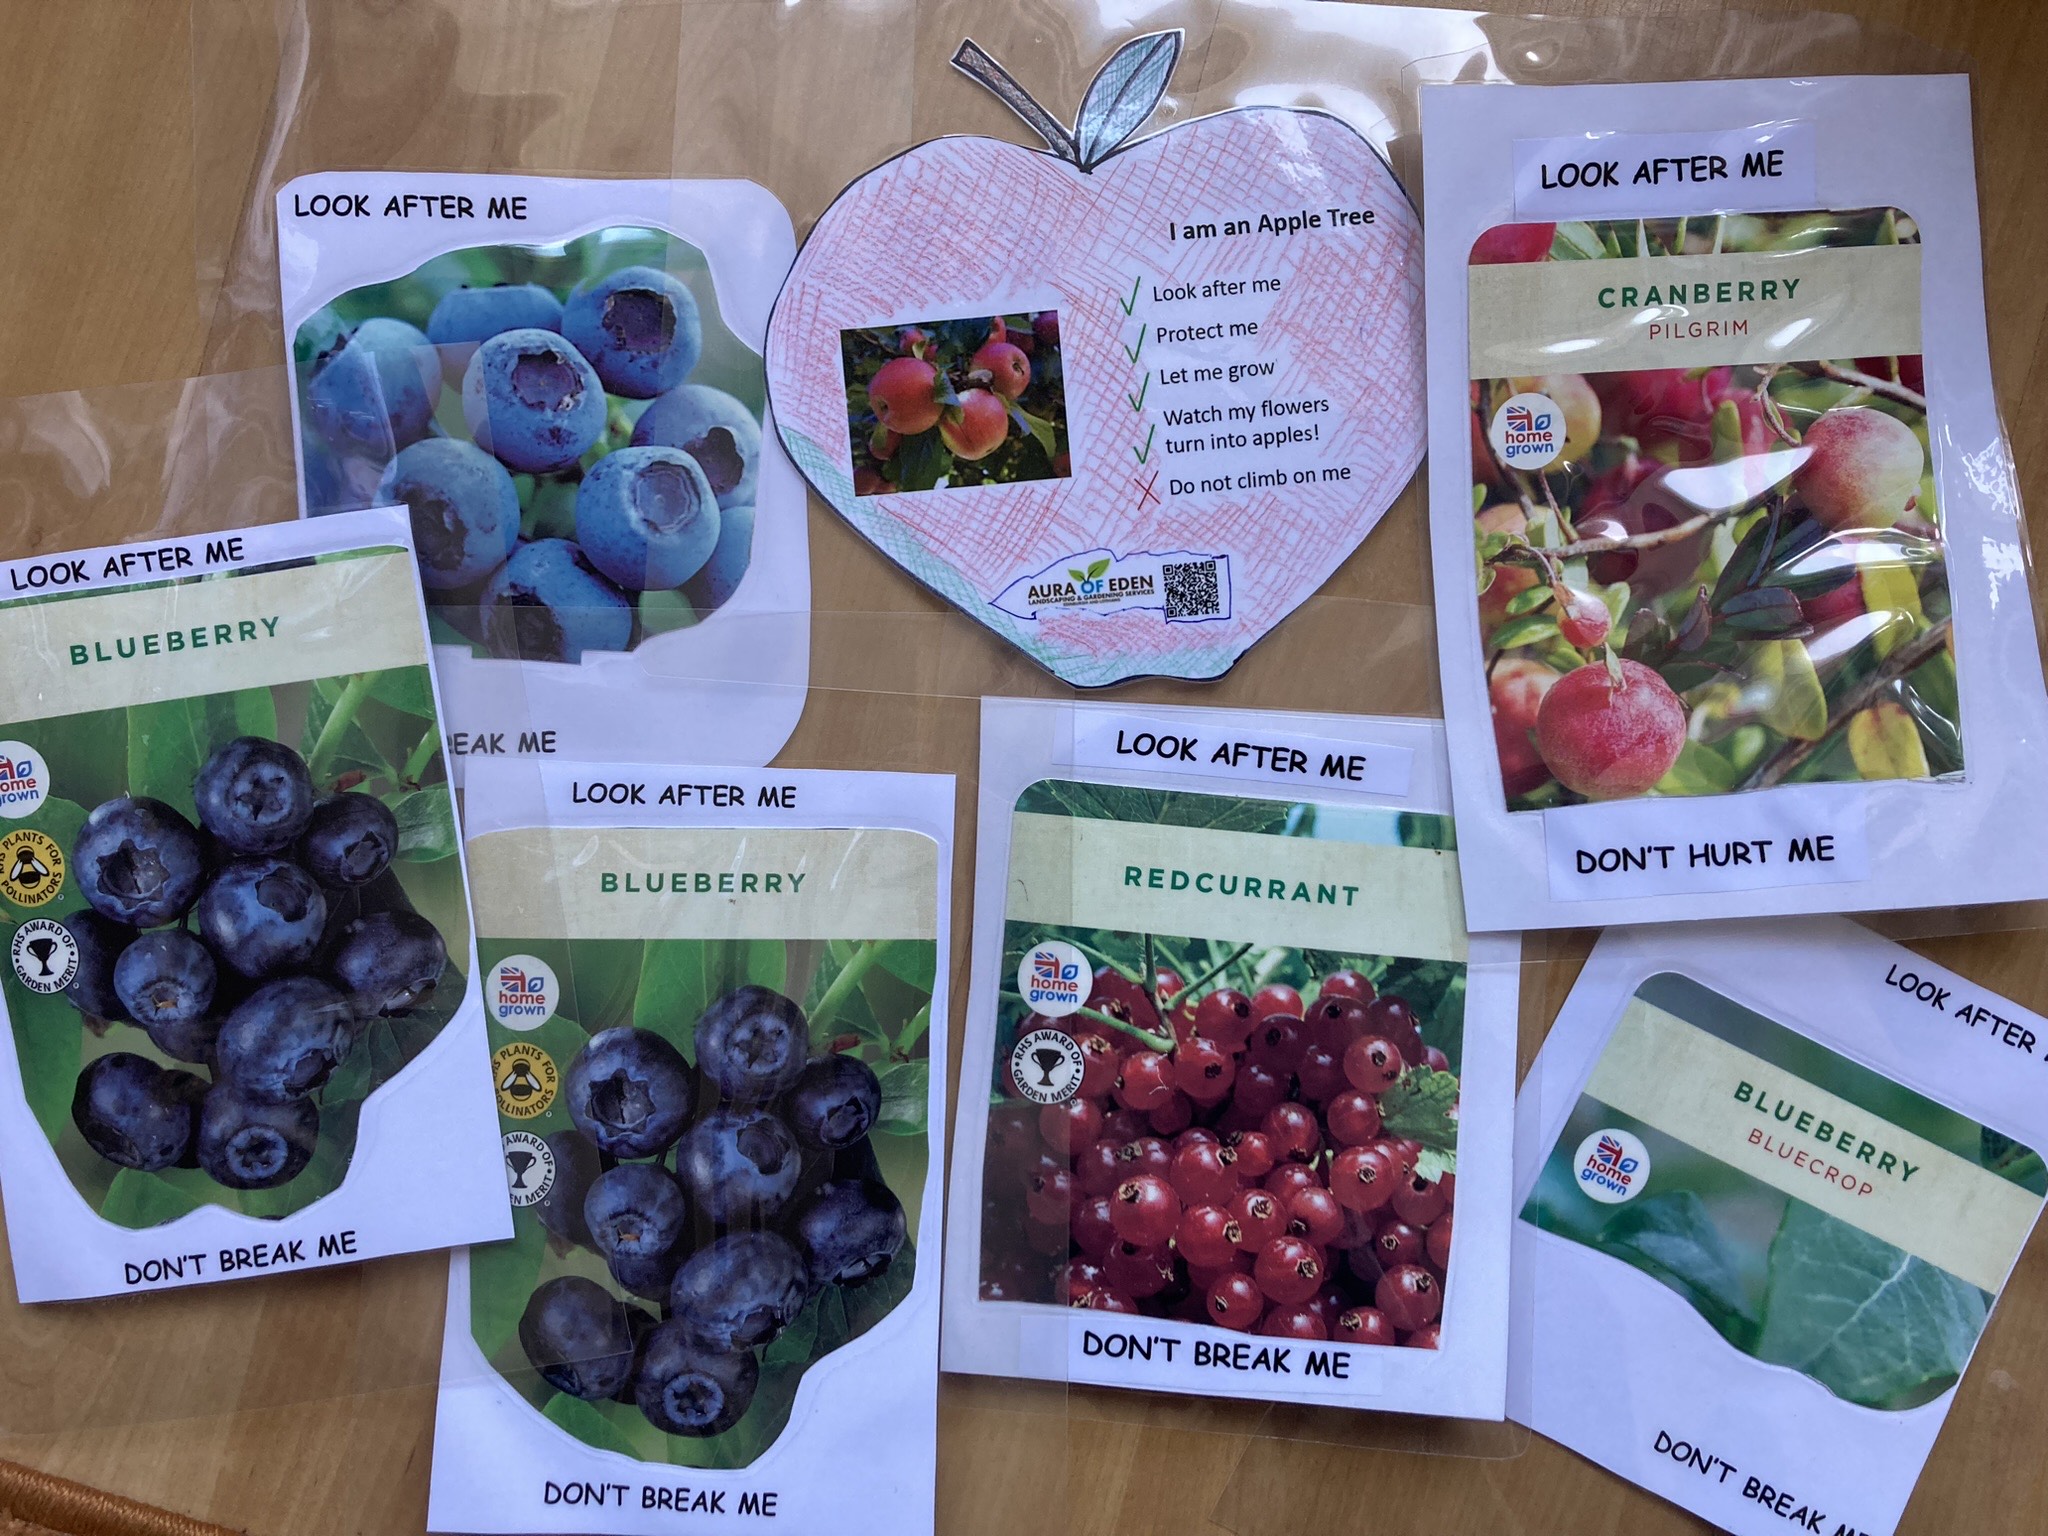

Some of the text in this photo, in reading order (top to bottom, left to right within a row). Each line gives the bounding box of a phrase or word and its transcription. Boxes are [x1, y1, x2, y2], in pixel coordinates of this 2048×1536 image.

[1541, 150, 1784, 189] LOOK AFTER ME
[294, 194, 527, 219] LOOK AFTER ME
[1170, 208, 1375, 240] I am an Apple Tree
[1153, 278, 1281, 302] Look after me
[1598, 278, 1800, 309] CRANBERRY
[1157, 321, 1258, 344] Protect me
[1650, 320, 1748, 340] PILGRIM
[1160, 361, 1275, 385] Let me grow
[1163, 398, 1329, 426] Watch my flowers
[1165, 424, 1319, 454] turn into apples!
[1505, 430, 1553, 444] home
[1506, 443, 1554, 458] grown
[1170, 466, 1351, 495] Do not climb on me
[11, 537, 245, 591] LOOK AFTER ME
[1028, 575, 1153, 599] AURA OF EDEN
[1028, 596, 1075, 606] LANDSCAPING
[1083, 592, 1124, 601] GARDENING
[1125, 589, 1154, 597] SERVICES
[69, 616, 280, 666] BLUEBERRY
[447, 731, 556, 755] EAK ME
[1116, 730, 1366, 781] LOOK AFTER ME
[0, 778, 36, 792] ome
[0, 790, 39, 807] rown
[572, 781, 797, 808] LOOK AFTER ME
[3, 832, 62, 867] PLANTS FOR
[1576, 835, 1834, 874] DON'T HURT ME
[1, 872, 62, 904] POLLINATORS
[601, 872, 806, 893] BLUEBERRY
[1124, 865, 1359, 906] REDCURRANT
[13, 921, 75, 956] RHS AWARD OF
[16, 959, 77, 992] GARDEN MERIT
[1031, 975, 1078, 992] home
[499, 990, 545, 1004] home
[499, 1005, 545, 1018] grown
[1029, 989, 1078, 1003] grown
[1885, 964, 2036, 1054] LOOK AFTER
[500, 1045, 556, 1083] PLANTS FOR
[1015, 1031, 1083, 1066] RHS AWARD OF
[1013, 1070, 1081, 1103] GARDEN MERIT
[1734, 1080, 1920, 1182] BLUEBERRY
[506, 1133, 553, 1166] AWARD OF
[1748, 1128, 1873, 1196] BLUECROP
[1581, 1168, 1627, 1196] grown
[1586, 1154, 1632, 1185] home
[525, 1176, 553, 1204] MERIT
[124, 1230, 357, 1285] DON'T BREAK ME
[1083, 1330, 1351, 1379] DON'T BREAK ME
[1654, 1430, 1826, 1534] DON'T BREAK
[544, 1480, 778, 1517] DON'T BREAK ME
